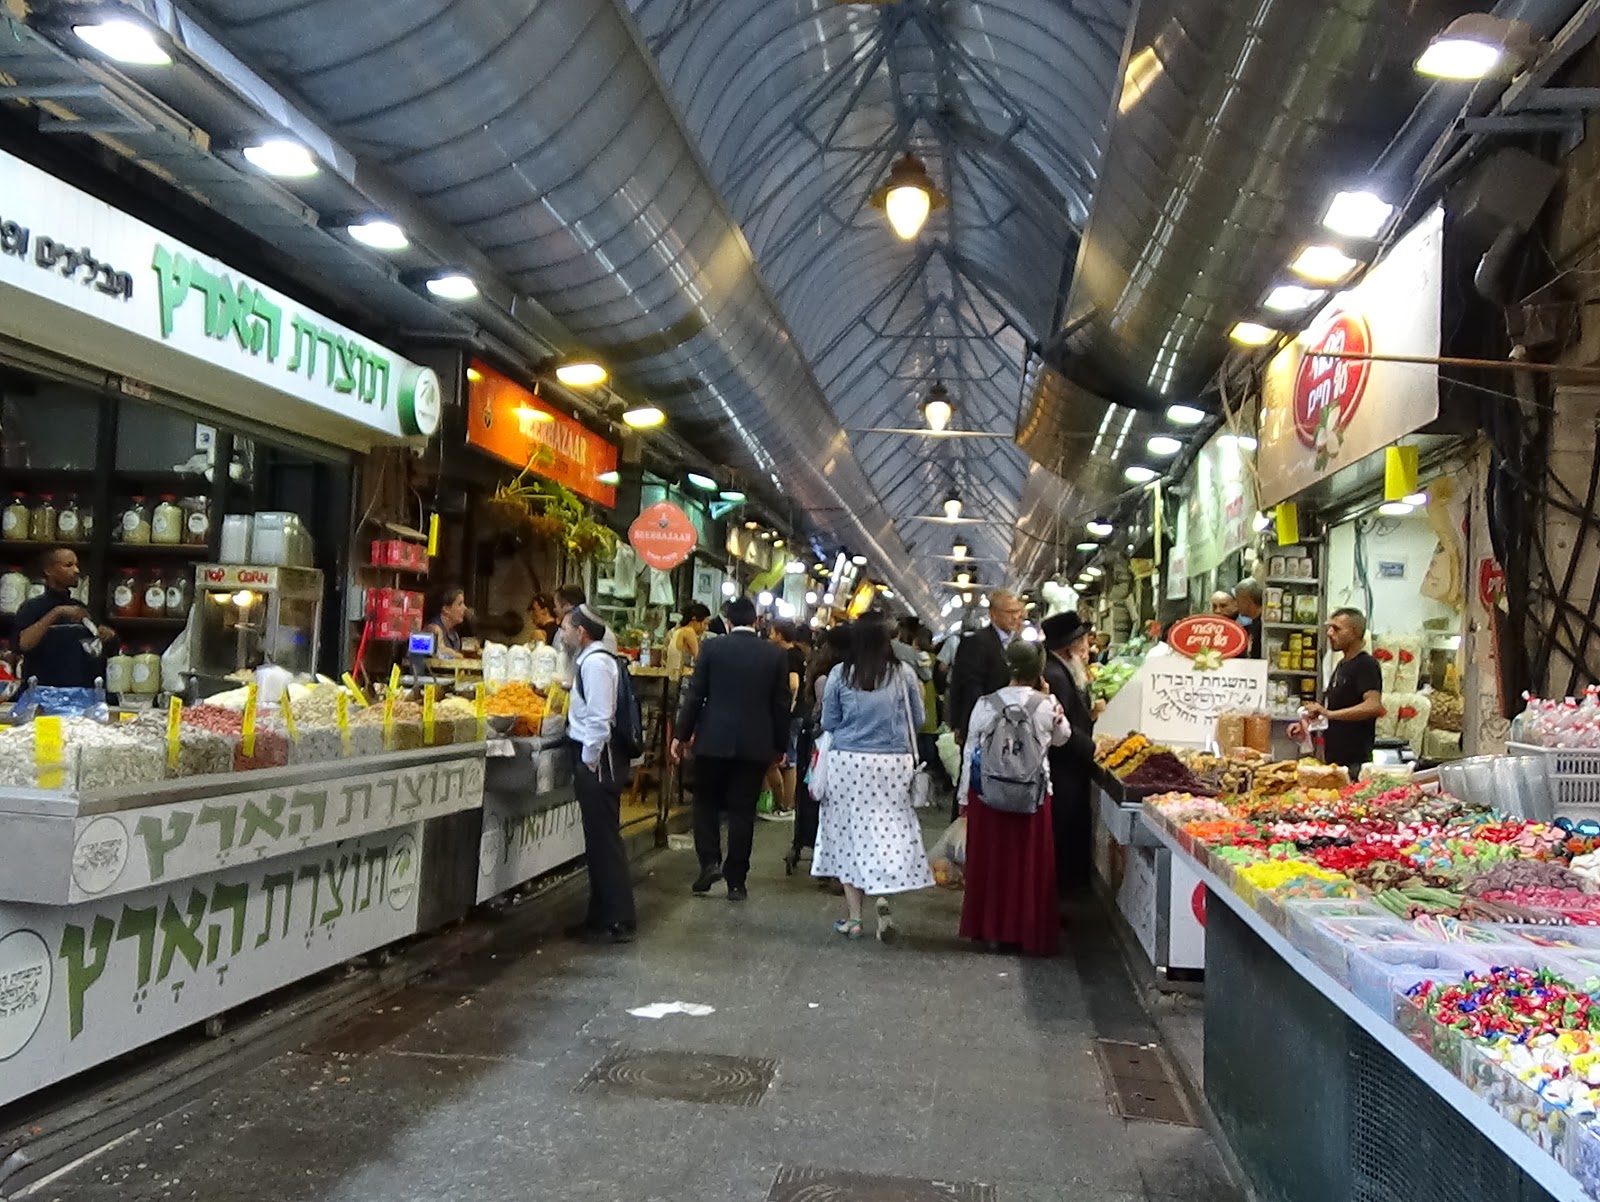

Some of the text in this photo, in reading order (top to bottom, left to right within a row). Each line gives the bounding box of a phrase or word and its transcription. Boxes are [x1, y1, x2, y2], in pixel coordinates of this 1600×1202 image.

[151, 242, 390, 411] תוצרת הארץ
[237, 569, 268, 583] CORN
[1200, 675, 1257, 690] בהשגחת
